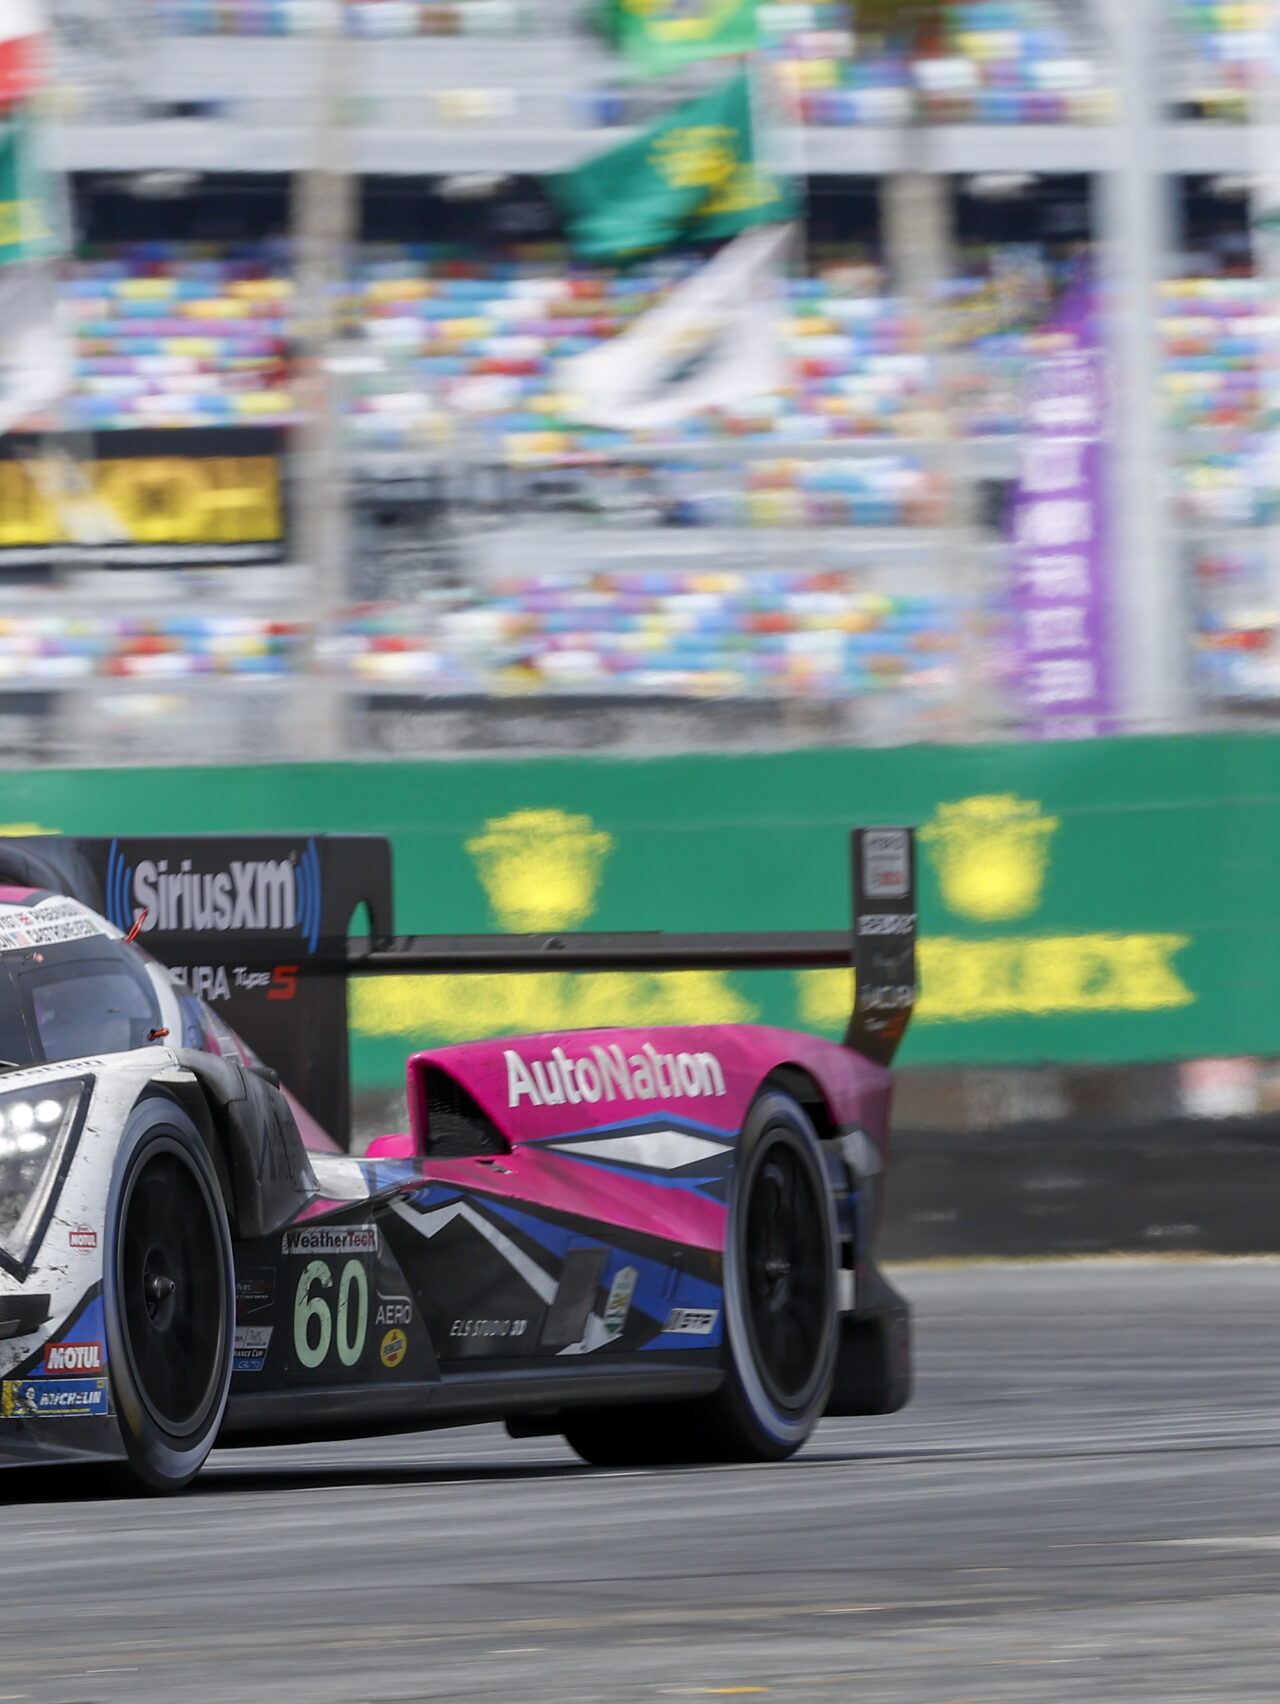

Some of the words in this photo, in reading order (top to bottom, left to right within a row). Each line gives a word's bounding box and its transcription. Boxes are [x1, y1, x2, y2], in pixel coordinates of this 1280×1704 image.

[133, 859, 297, 932] SiriusXM
[232, 966, 271, 989] Type
[267, 965, 299, 999] S
[504, 1042, 727, 1108] AutoNation
[287, 1229, 376, 1249] WeatherTech
[294, 1259, 368, 1368] 60
[375, 1304, 413, 1325] AERO
[449, 1319, 473, 1337] ELS
[47, 1346, 101, 1370] MOTUL
[40, 1391, 102, 1405] MICHELIN
